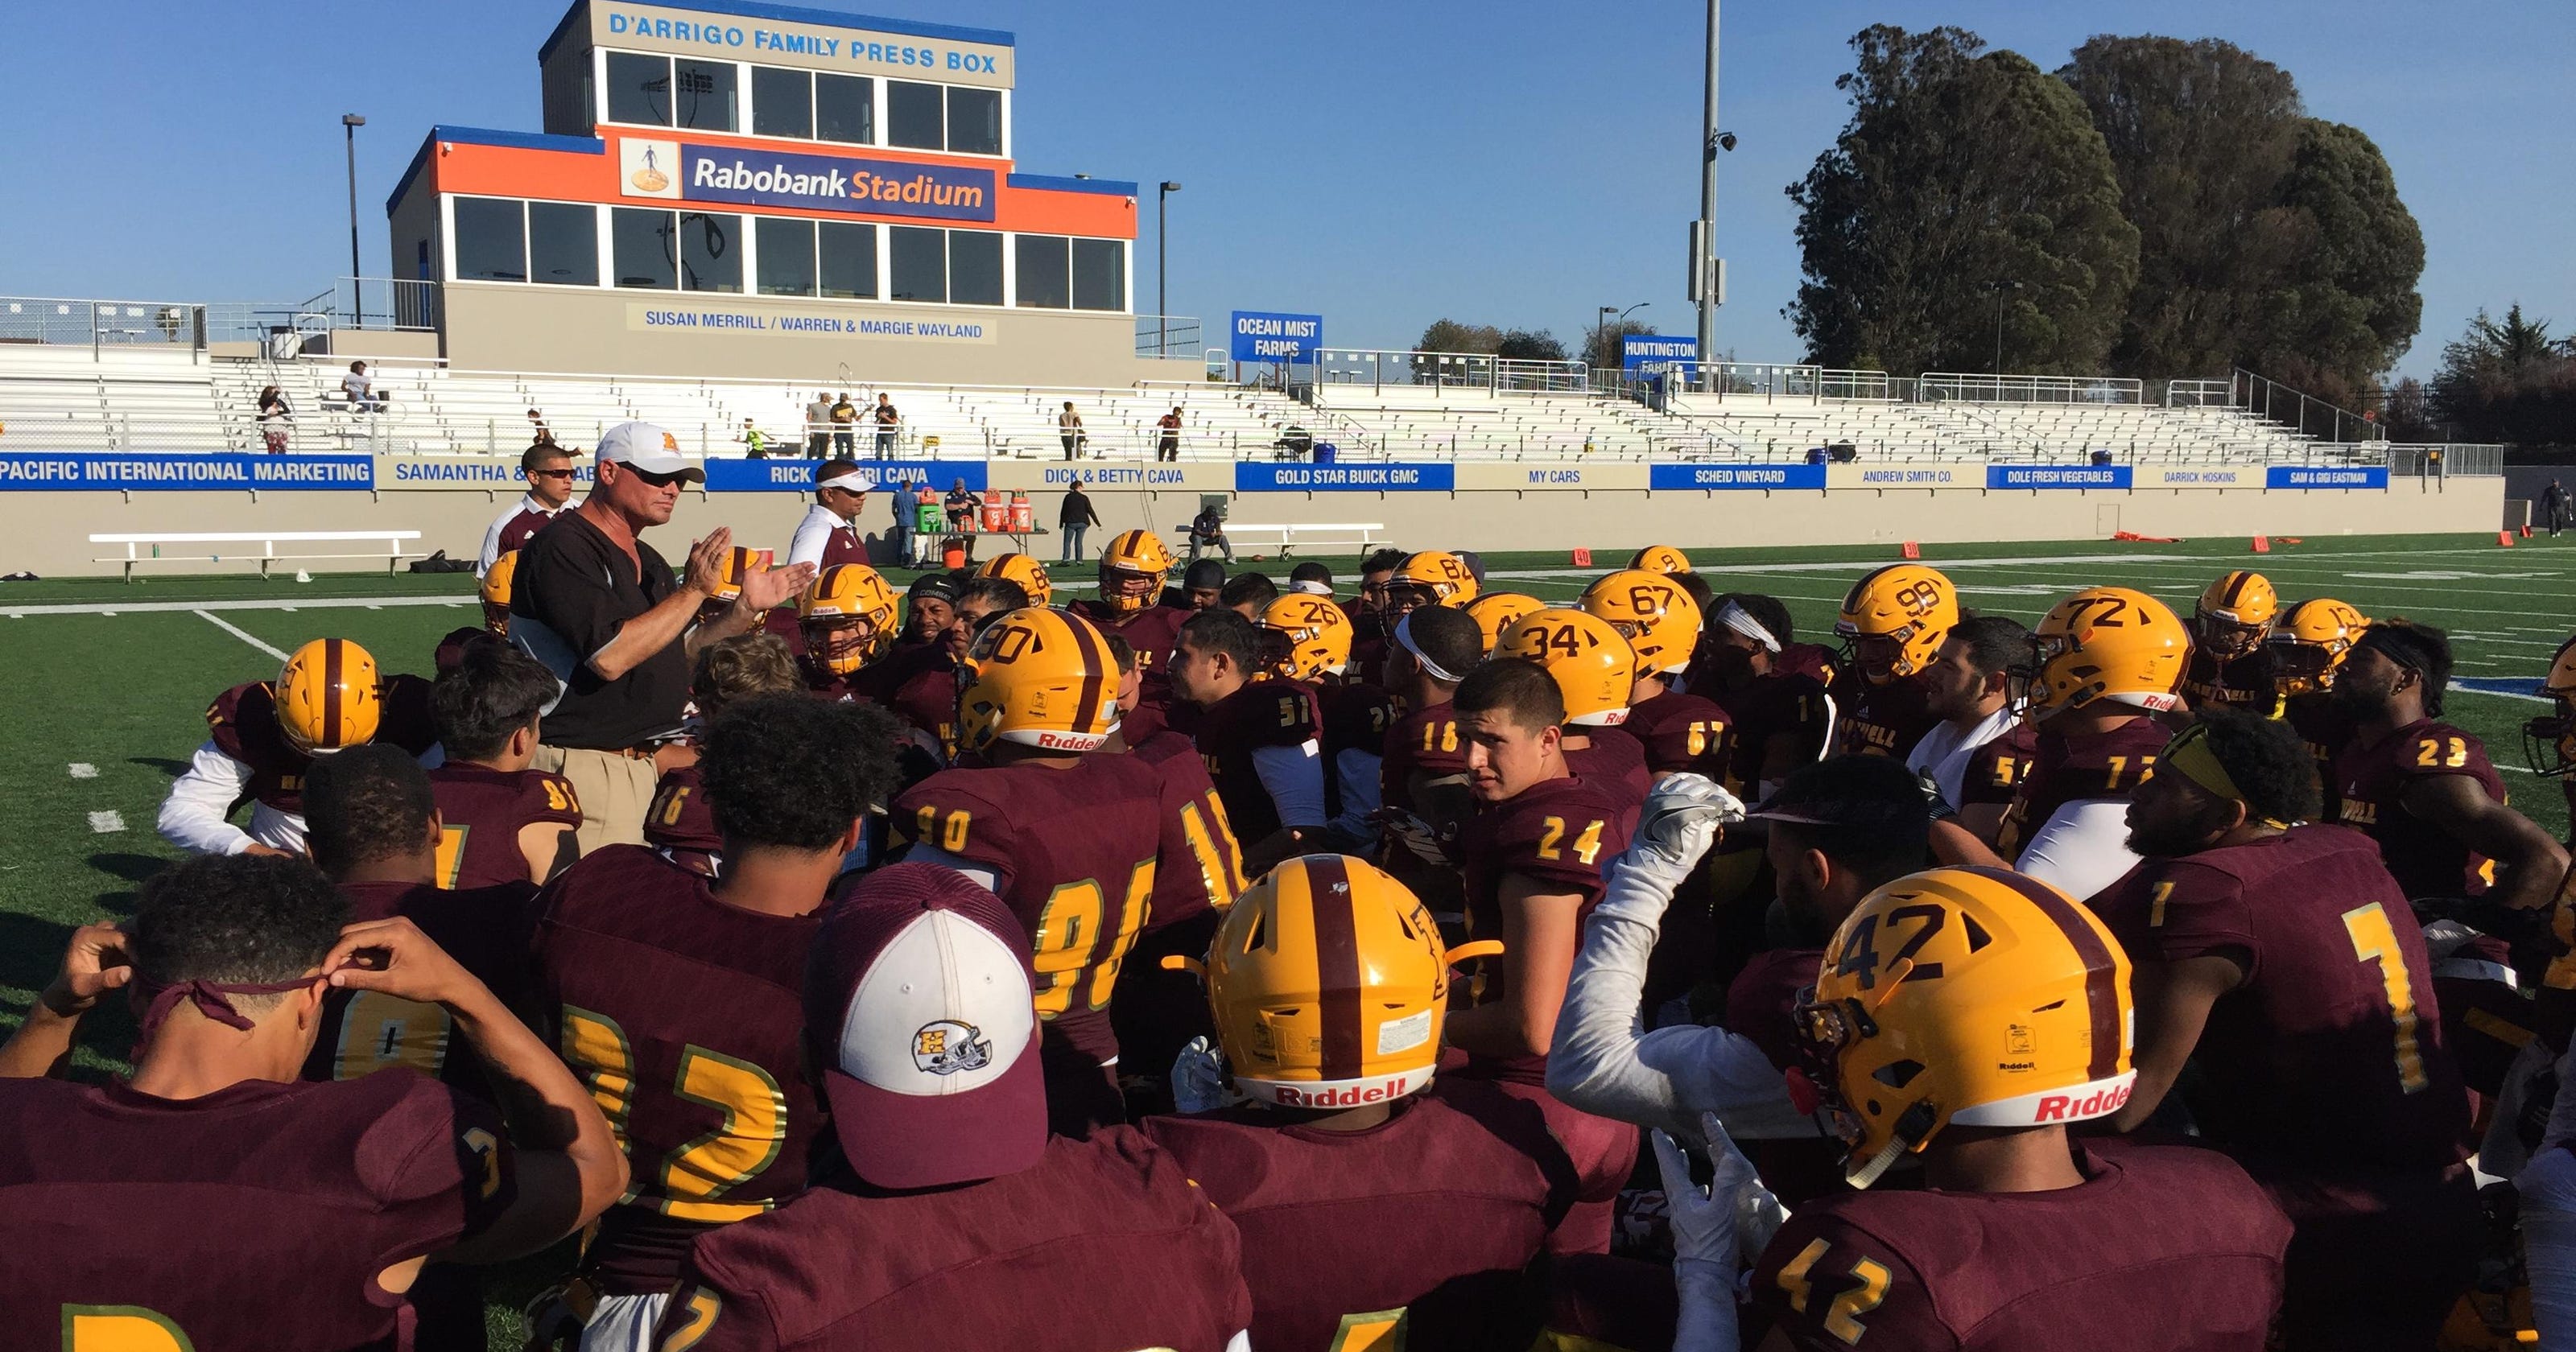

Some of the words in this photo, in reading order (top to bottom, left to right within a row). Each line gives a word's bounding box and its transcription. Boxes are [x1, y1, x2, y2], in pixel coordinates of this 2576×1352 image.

[610, 14, 745, 47] D'ARRIGO
[754, 30, 840, 58] FAMILY
[851, 42, 935, 68] PRESS
[947, 52, 997, 75] BOX
[694, 158, 847, 198] Rabobank
[850, 171, 984, 208] Stadium
[646, 311, 698, 328] SUSAN
[702, 312, 766, 330] MERRILL
[770, 315, 778, 331] /
[780, 316, 842, 332] WARREN
[845, 319, 857, 334] &
[860, 319, 914, 336] MARGIE
[917, 321, 983, 338] WAYLAND
[1237, 318, 1282, 336] OCEAN
[1285, 320, 1316, 337] MIST
[1255, 340, 1299, 357] FARMS
[1625, 342, 1695, 357] HUNTINGTON
[0, 461, 80, 480] PACIFIC
[85, 461, 248, 481] INTERNATIONAL
[254, 463, 369, 481] MARKETING
[396, 463, 508, 481] SAMANTHA
[770, 467, 811, 484] RICK
[886, 468, 928, 484] CAVA
[1046, 469, 1079, 484] DICK
[1084, 470, 1094, 483] &
[1099, 469, 1144, 483] BETTY
[1148, 470, 1184, 483] CAVA
[1275, 470, 1310, 484] GOLD
[1313, 470, 1346, 484] STAR
[1349, 470, 1388, 484] BUICK
[1390, 470, 1418, 484] GMC
[1530, 471, 1546, 483] MY
[1550, 471, 1580, 483] CARS
[1695, 470, 1732, 484] SCHEID
[1735, 470, 1785, 483] VINEYARD
[1863, 471, 1904, 483] ANDREW
[1906, 471, 1936, 483] SMITH
[2008, 471, 2030, 484] DOLE
[2032, 471, 2060, 483] FRESH
[2061, 471, 2114, 483] VEGETABLES
[2165, 472, 2200, 483] DARRICK
[2202, 472, 2235, 483] HOSKINS
[2290, 472, 2308, 483] SAM
[2332, 472, 2367, 484] EASTMAN
[1576, 550, 1589, 563] 40
[1906, 544, 1918, 555] 30
[1629, 586, 1674, 615] 67
[1896, 580, 1939, 616] 98
[1300, 601, 1344, 625] 26
[2067, 597, 2127, 630] 72
[972, 623, 1033, 665] 90
[1521, 624, 1580, 661] 34
[1038, 732, 1106, 749] Riddell
[2417, 736, 2468, 767] 23
[1537, 815, 1604, 865] 24
[1836, 903, 1946, 991] 42
[917, 1028, 948, 1056] H
[1999, 1062, 2035, 1071] Riddell
[1275, 1077, 1406, 1107] Riddell
